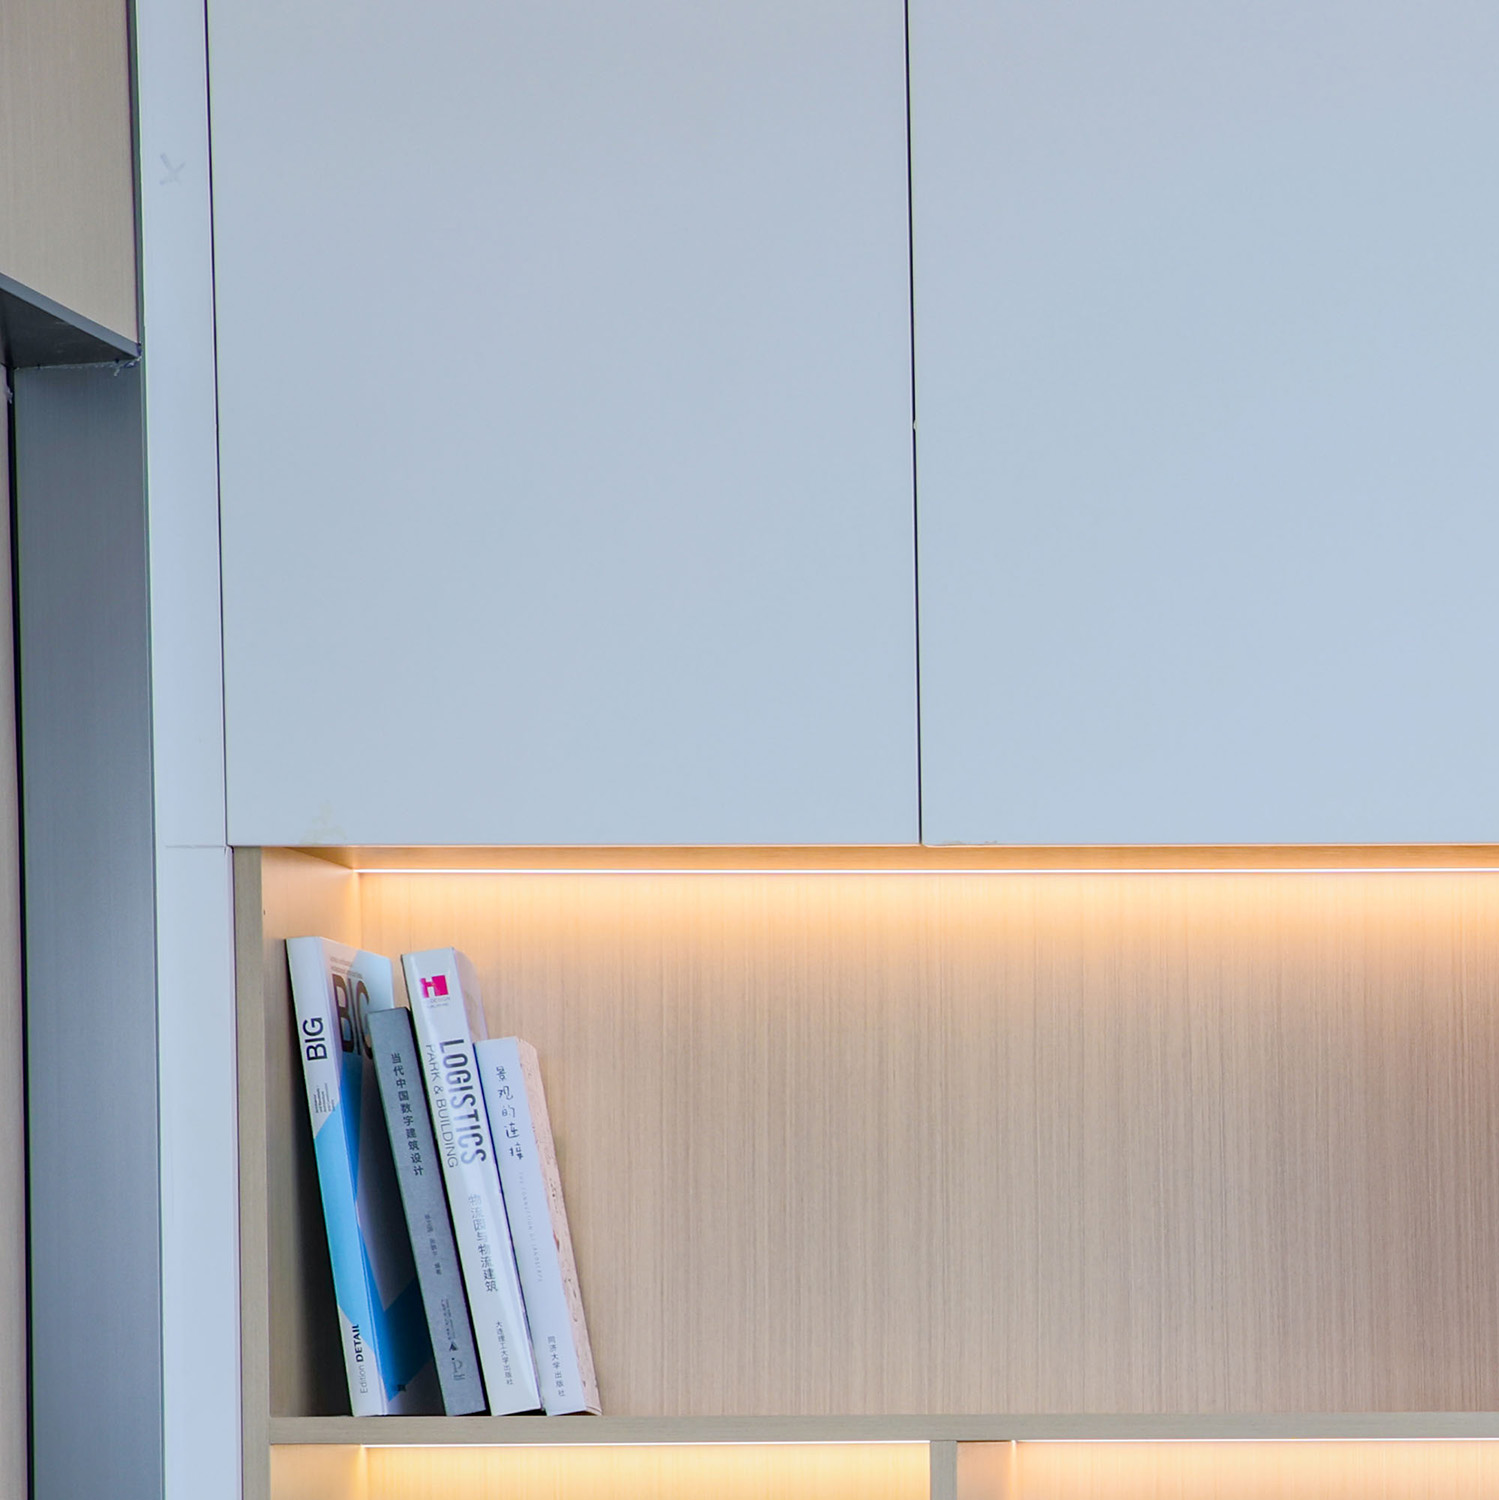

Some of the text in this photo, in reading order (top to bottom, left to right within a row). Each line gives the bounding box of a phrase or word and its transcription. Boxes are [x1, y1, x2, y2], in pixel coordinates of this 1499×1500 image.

[302, 1017, 327, 1061] BIG
[391, 1053, 424, 1176] 当代中国数字建筑设计
[436, 1099, 458, 1168] BUILDING
[439, 1039, 486, 1164] LOGISTICS
[352, 1324, 368, 1393] Edition DETAIL
